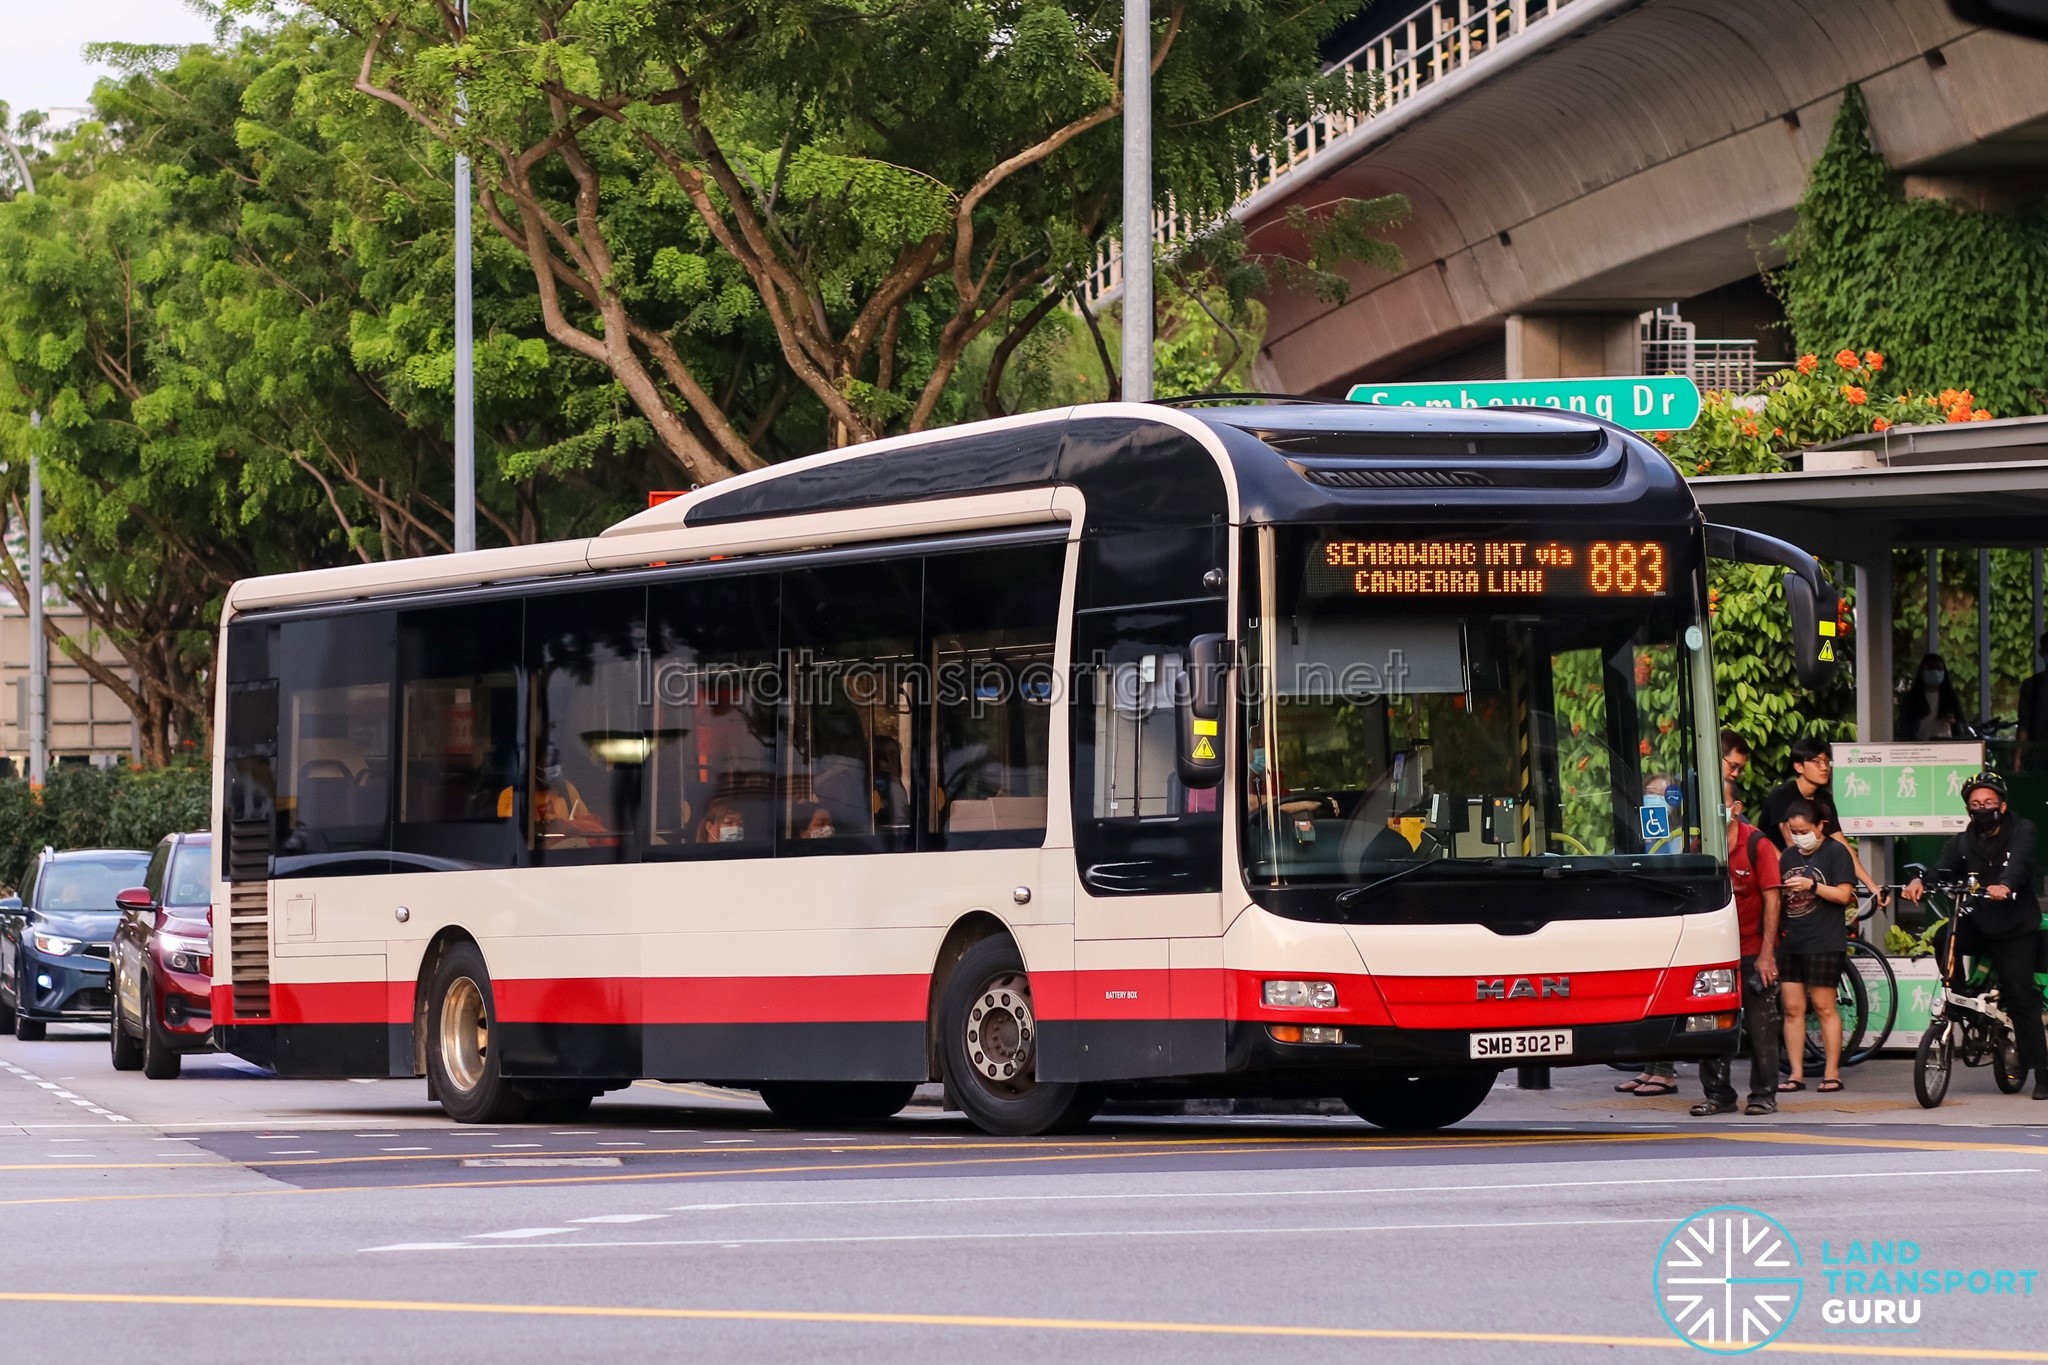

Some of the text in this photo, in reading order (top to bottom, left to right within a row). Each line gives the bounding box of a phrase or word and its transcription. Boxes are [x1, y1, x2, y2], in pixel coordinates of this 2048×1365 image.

[1632, 384, 1676, 416] Dr
[1326, 542, 1574, 566] SEMBAWANG INT via
[1590, 542, 1663, 593] 883
[1354, 569, 1543, 593] CANBERRA LINK
[1105, 991, 1138, 999] BATTERY BOX
[1475, 976, 1570, 1000] MAN
